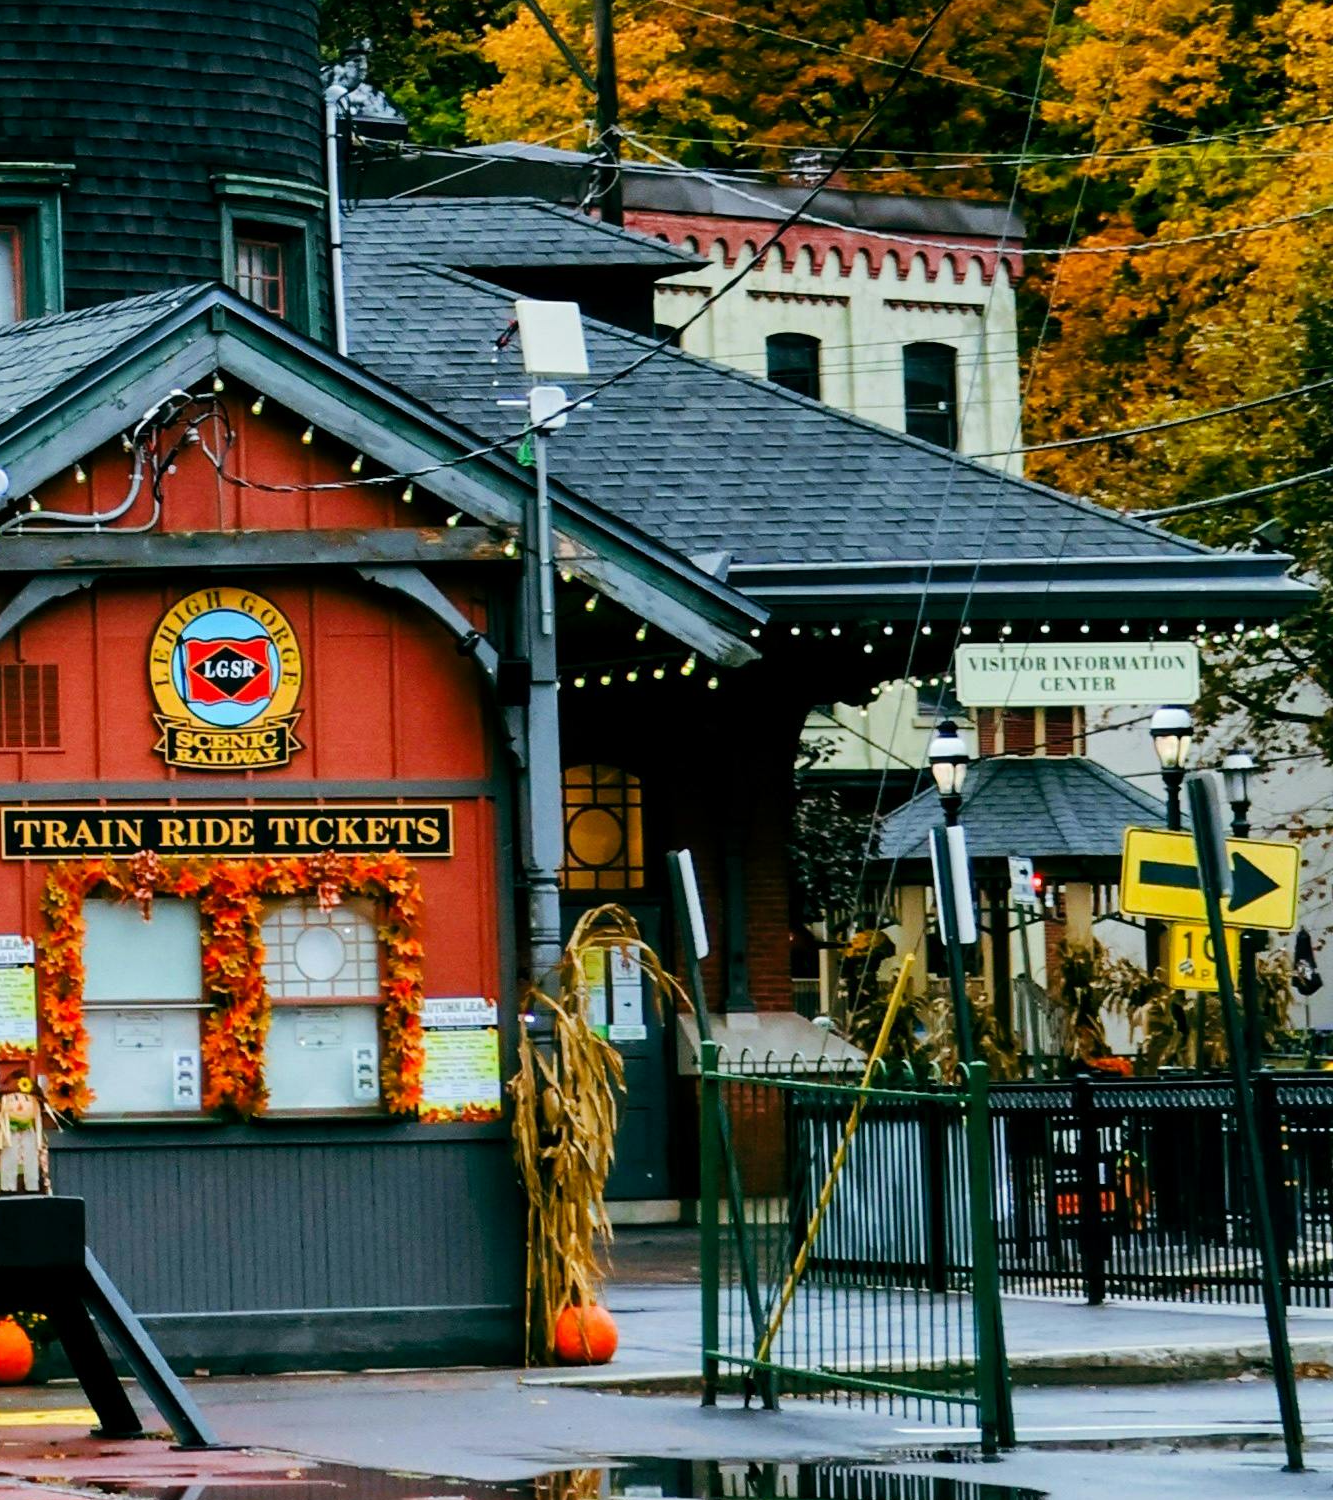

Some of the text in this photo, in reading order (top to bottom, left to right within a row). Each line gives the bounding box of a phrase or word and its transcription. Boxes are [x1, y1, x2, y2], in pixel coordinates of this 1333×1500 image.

[153, 590, 299, 687] LEHIGH GORGE
[203, 659, 256, 679] LGSR
[967, 655, 1186, 672] VISITOR INFORMATION
[1040, 676, 1117, 692] CENTER
[174, 730, 278, 749] SCENIC
[174, 747, 281, 765] RAILWAY
[13, 816, 441, 849] TRAIN RIDE TICKETS
